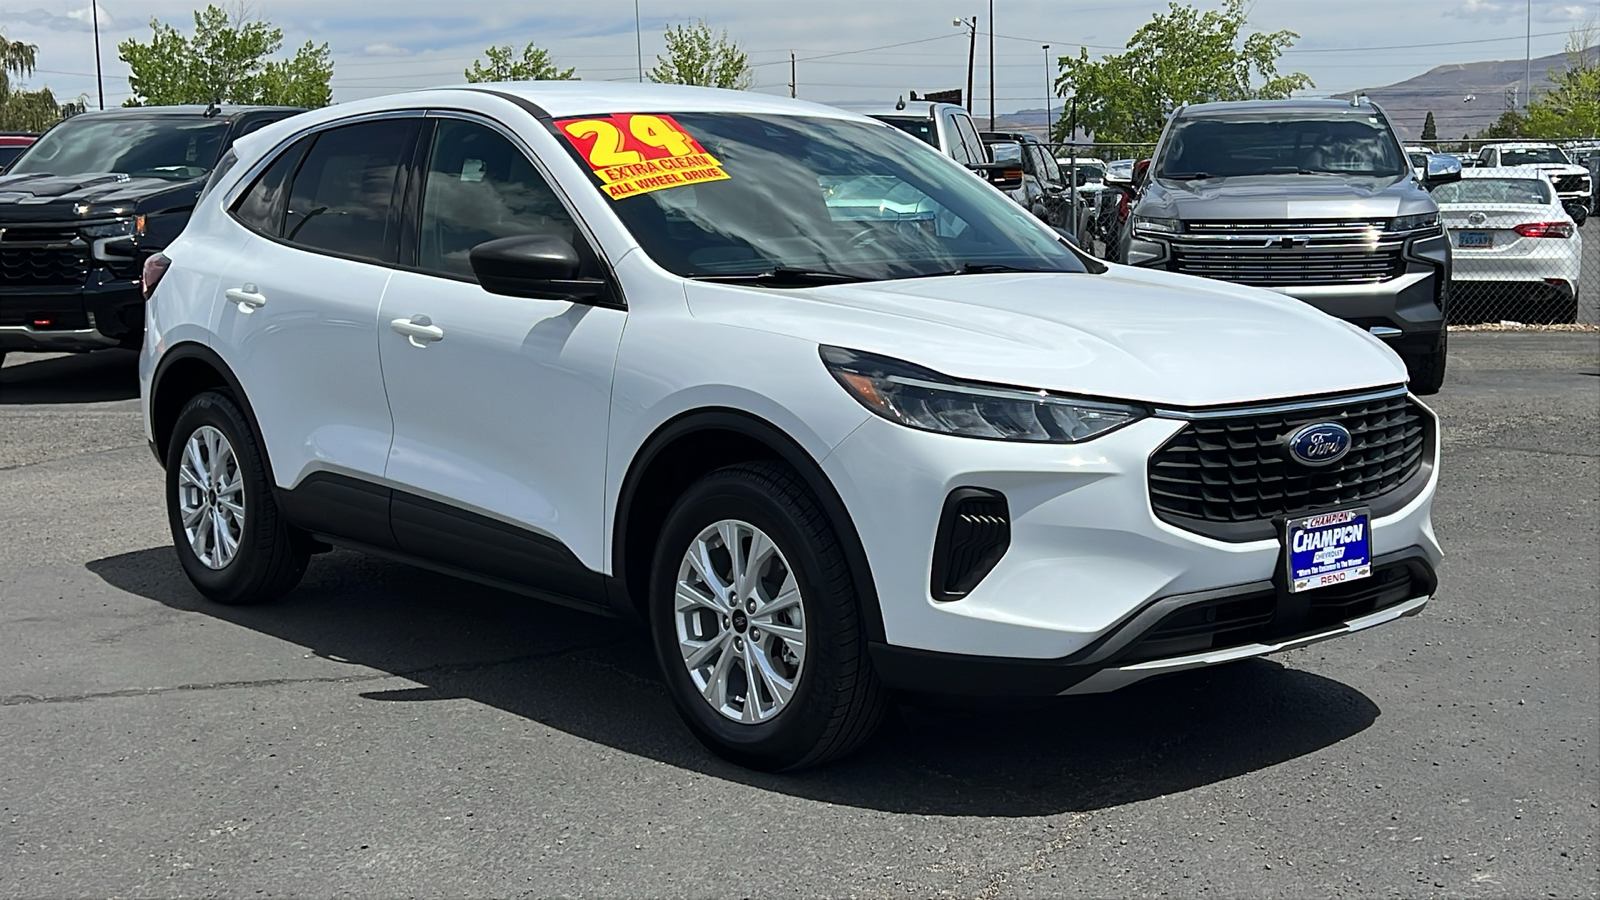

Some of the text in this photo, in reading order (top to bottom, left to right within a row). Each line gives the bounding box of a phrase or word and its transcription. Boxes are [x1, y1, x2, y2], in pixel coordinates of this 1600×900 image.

[565, 114, 695, 167] 24
[604, 155, 708, 181] EXTRA CLEAN
[609, 167, 722, 198] ALL WHEEL DRIVE
[1307, 432, 1341, 456] Ford
[1311, 512, 1348, 527] CHAMPION
[1293, 523, 1364, 553] CHAMPION
[1316, 549, 1342, 560] CHEVROLET
[1320, 572, 1346, 585] RENO
